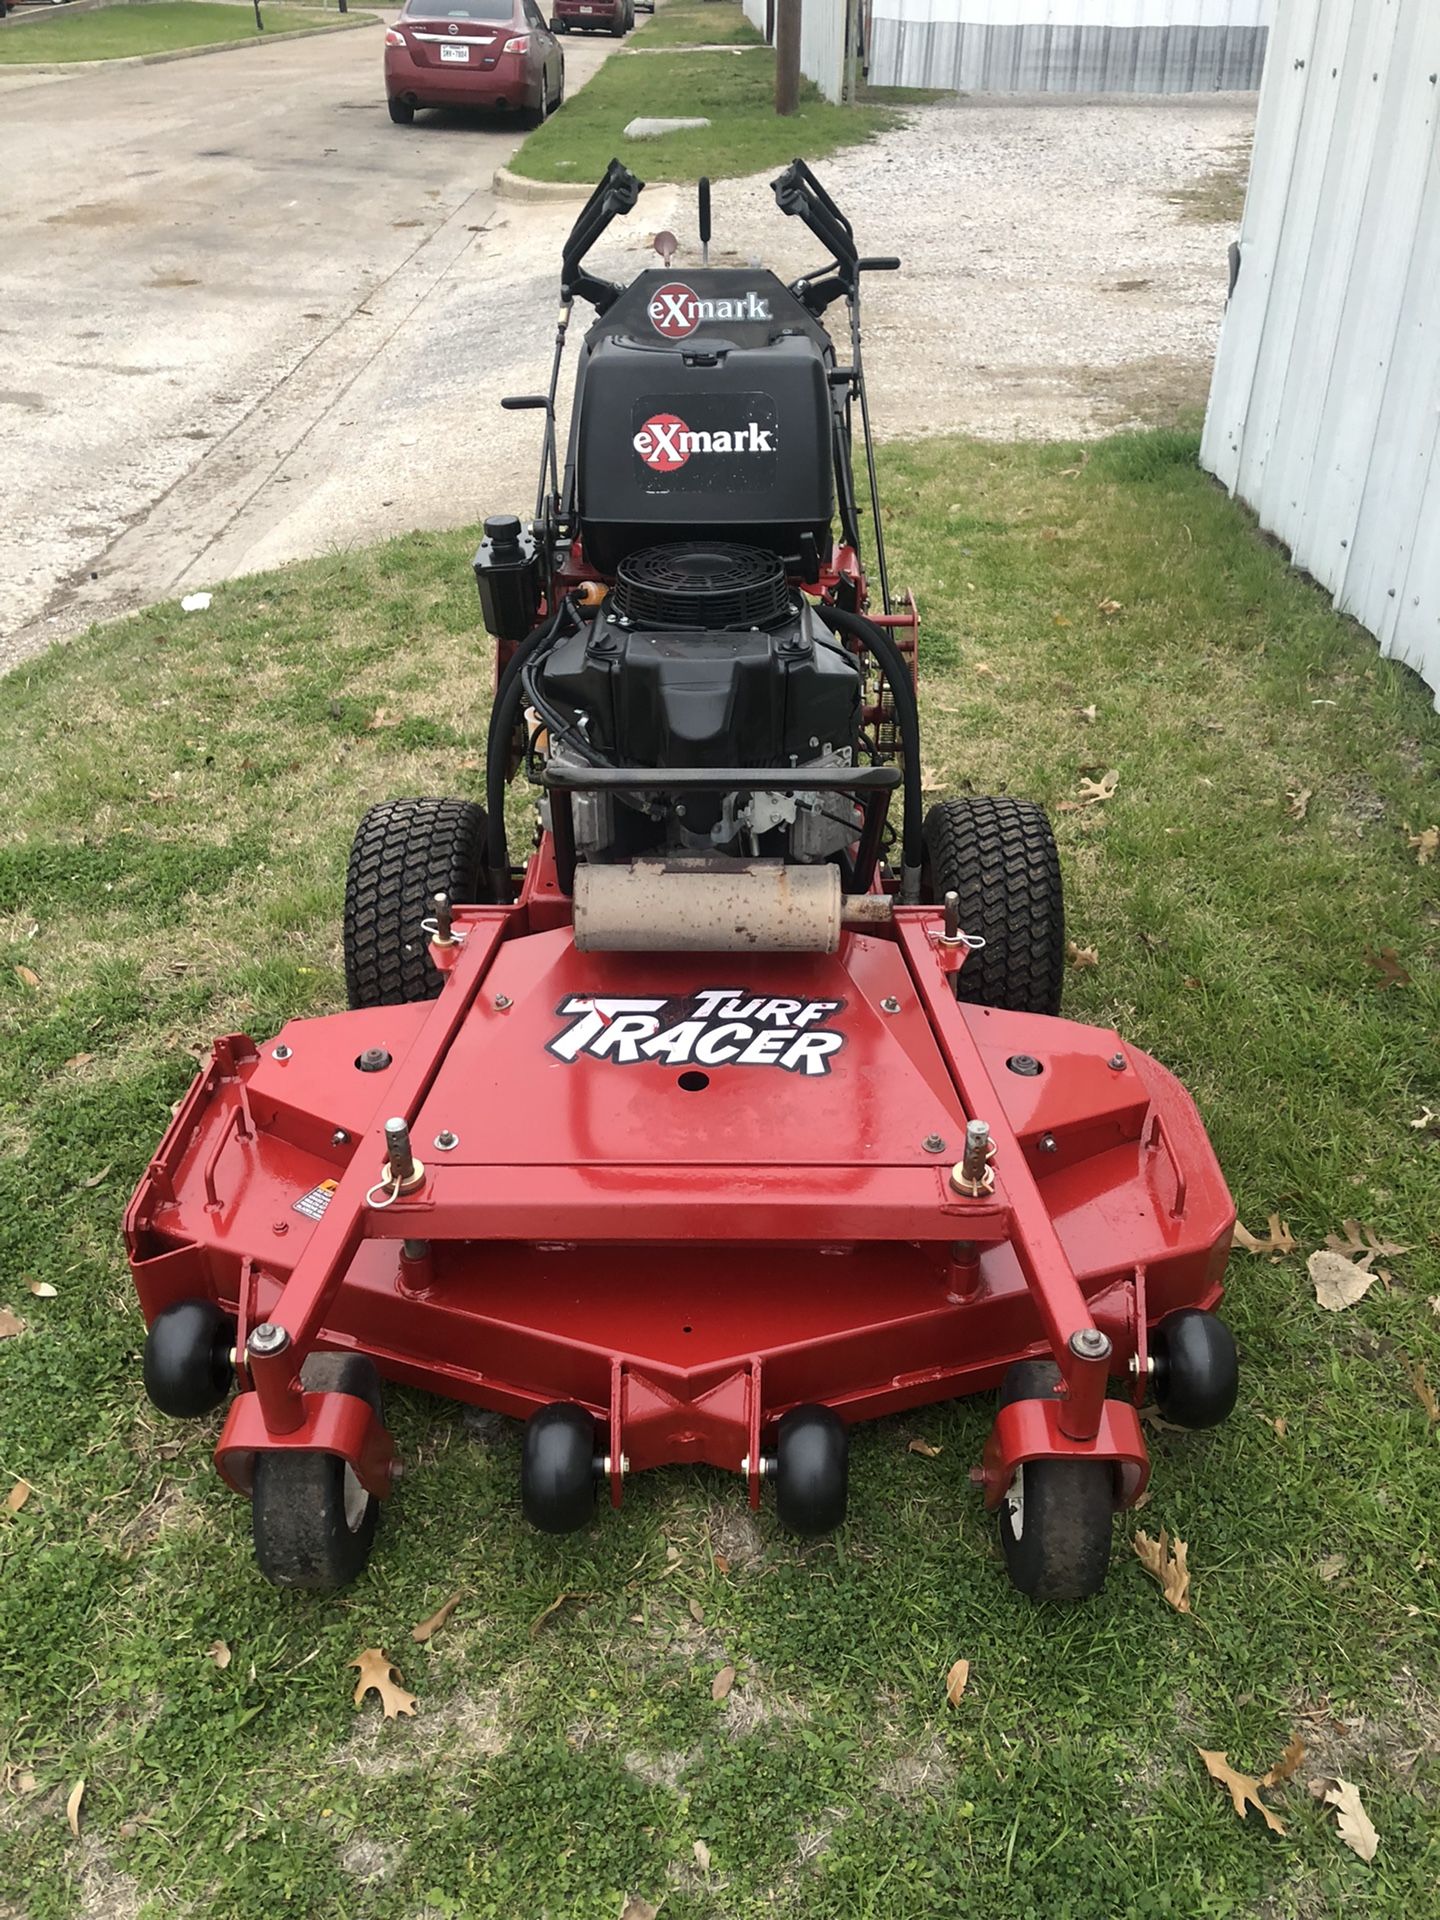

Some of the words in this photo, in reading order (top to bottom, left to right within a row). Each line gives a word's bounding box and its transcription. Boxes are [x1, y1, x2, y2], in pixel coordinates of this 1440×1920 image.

[649, 293, 772, 328] eXmark
[632, 422, 775, 463] eXmark
[690, 989, 839, 1028] TURF
[550, 998, 844, 1075] TRACER
